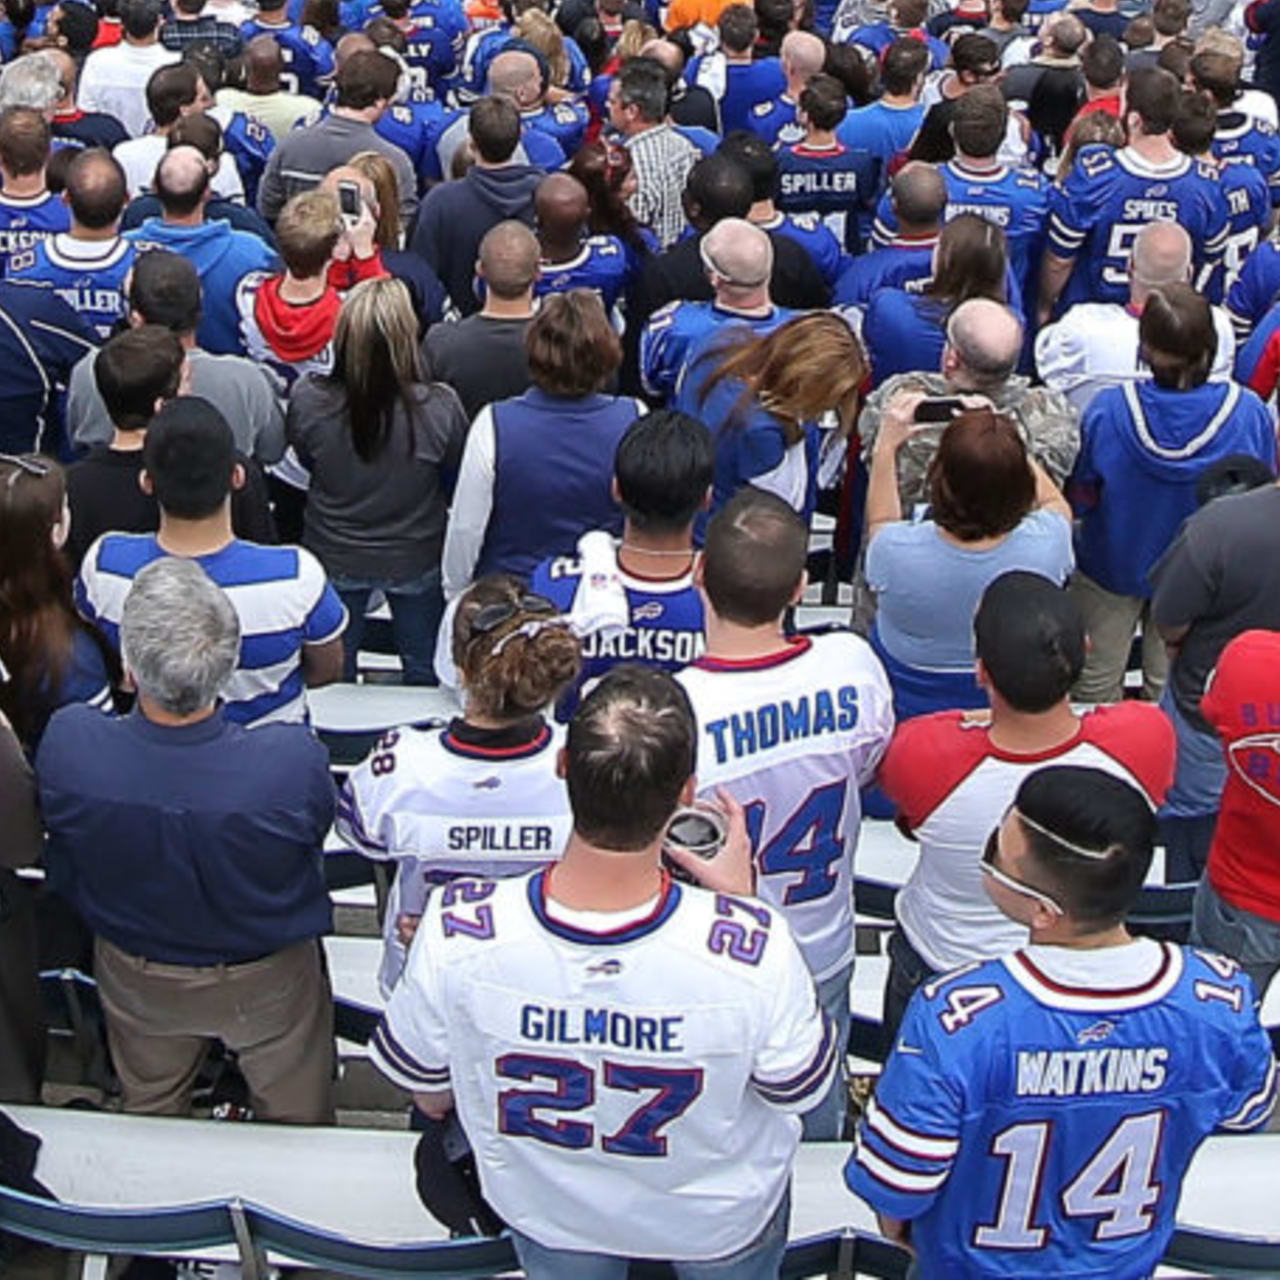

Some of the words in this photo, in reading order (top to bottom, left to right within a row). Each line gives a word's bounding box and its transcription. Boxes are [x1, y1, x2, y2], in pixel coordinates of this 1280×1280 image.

[780, 171, 857, 196] SPILLER
[1122, 198, 1178, 223] SPIKES
[55, 289, 120, 313] ILLER
[581, 627, 705, 663] JACKSON
[704, 685, 860, 765] THOMAS
[447, 825, 554, 852] SPILLER
[520, 1004, 685, 1053] GILMORE
[1016, 1047, 1170, 1097] WATKINS
[495, 1052, 705, 1158] 27
[973, 1109, 1170, 1251] 14
